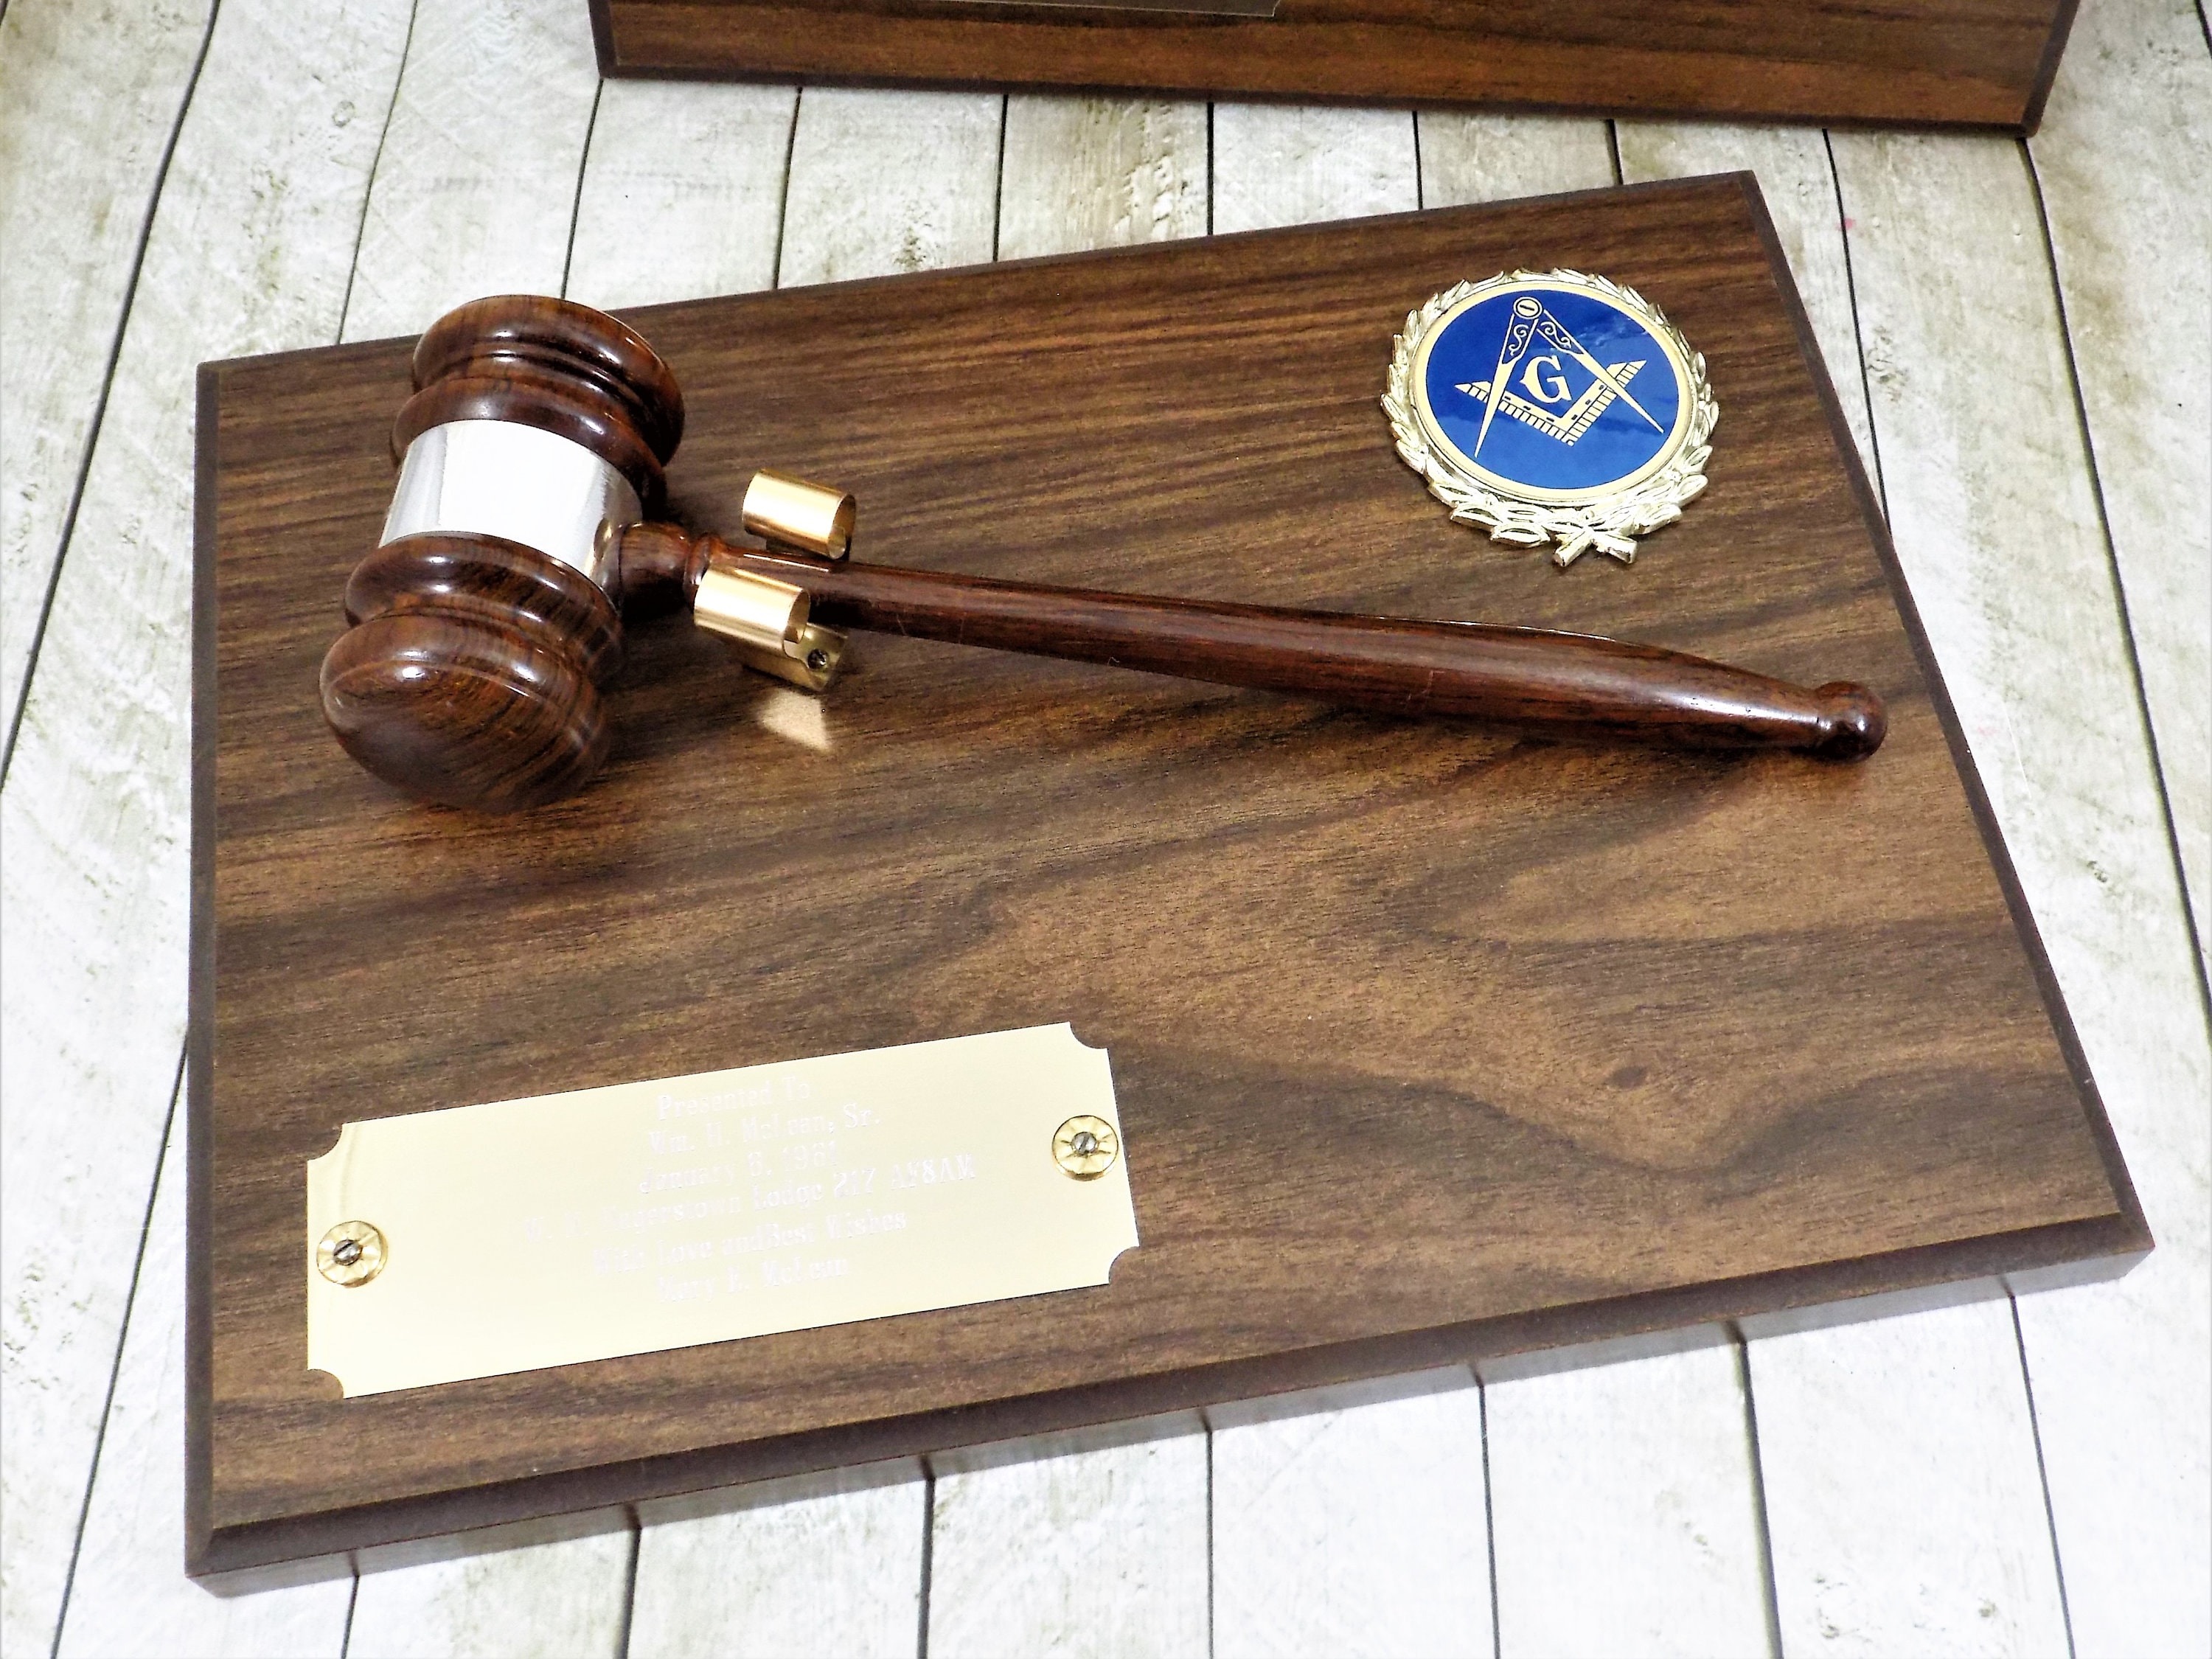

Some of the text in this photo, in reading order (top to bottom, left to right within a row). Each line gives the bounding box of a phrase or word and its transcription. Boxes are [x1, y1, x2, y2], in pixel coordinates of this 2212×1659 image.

[1518, 355, 1572, 403] G
[657, 1075, 811, 1120] Presented To
[843, 1102, 881, 1127] Sr.
[639, 1164, 733, 1194] January
[751, 1180, 824, 1211] Lodge
[833, 1166, 877, 1198] 217
[656, 1239, 713, 1266] Love
[826, 1208, 908, 1239] Wishes
[657, 1273, 715, 1302] Mary
